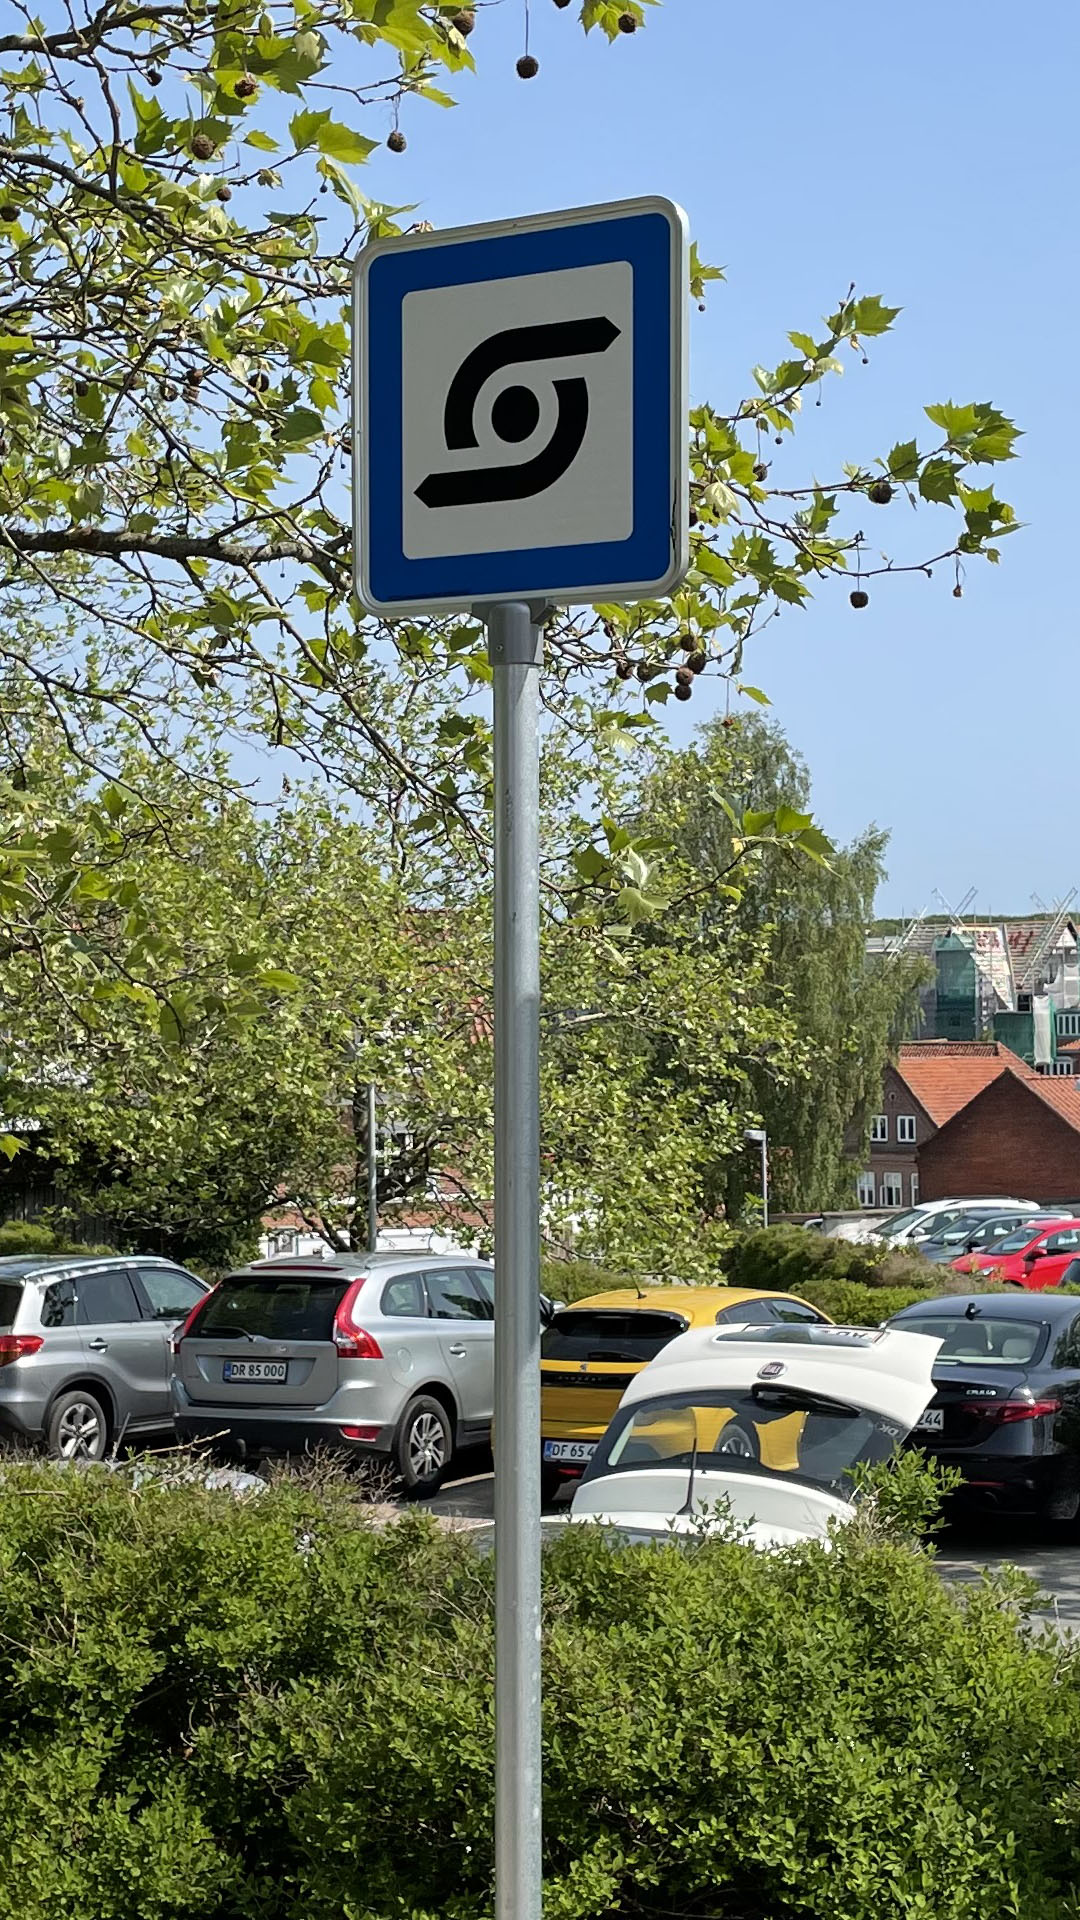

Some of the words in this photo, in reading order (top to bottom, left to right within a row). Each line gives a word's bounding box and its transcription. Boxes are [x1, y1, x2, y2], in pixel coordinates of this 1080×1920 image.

[231, 1364, 246, 1376] DR
[248, 1365, 261, 1377] 85
[264, 1365, 284, 1377] 000
[879, 1423, 899, 1436] DK
[552, 1444, 568, 1457] DF
[570, 1445, 585, 1457] 65
